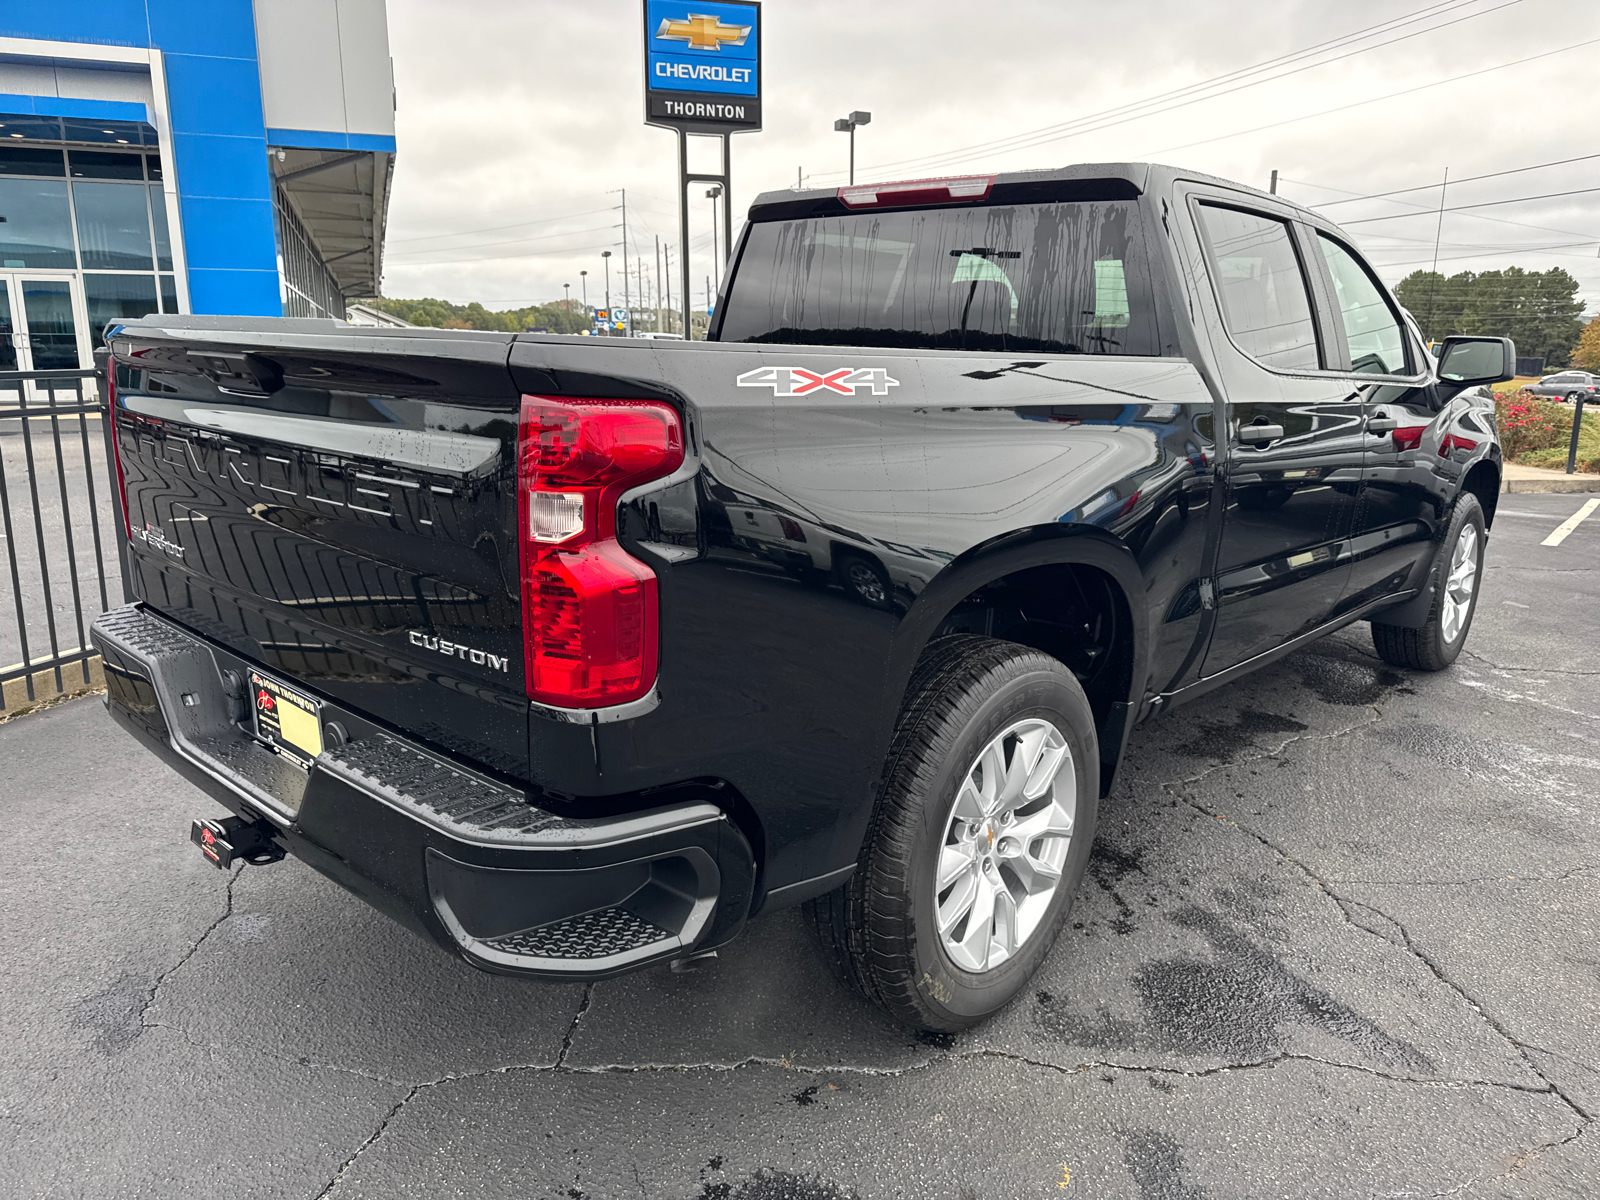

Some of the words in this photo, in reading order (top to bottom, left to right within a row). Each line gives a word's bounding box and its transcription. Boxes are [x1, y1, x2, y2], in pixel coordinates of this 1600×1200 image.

[655, 61, 752, 83] CHEVROLET
[664, 100, 745, 119] THORNTON
[117, 417, 454, 525] CHEVROLET
[408, 630, 509, 673] CUSTOM
